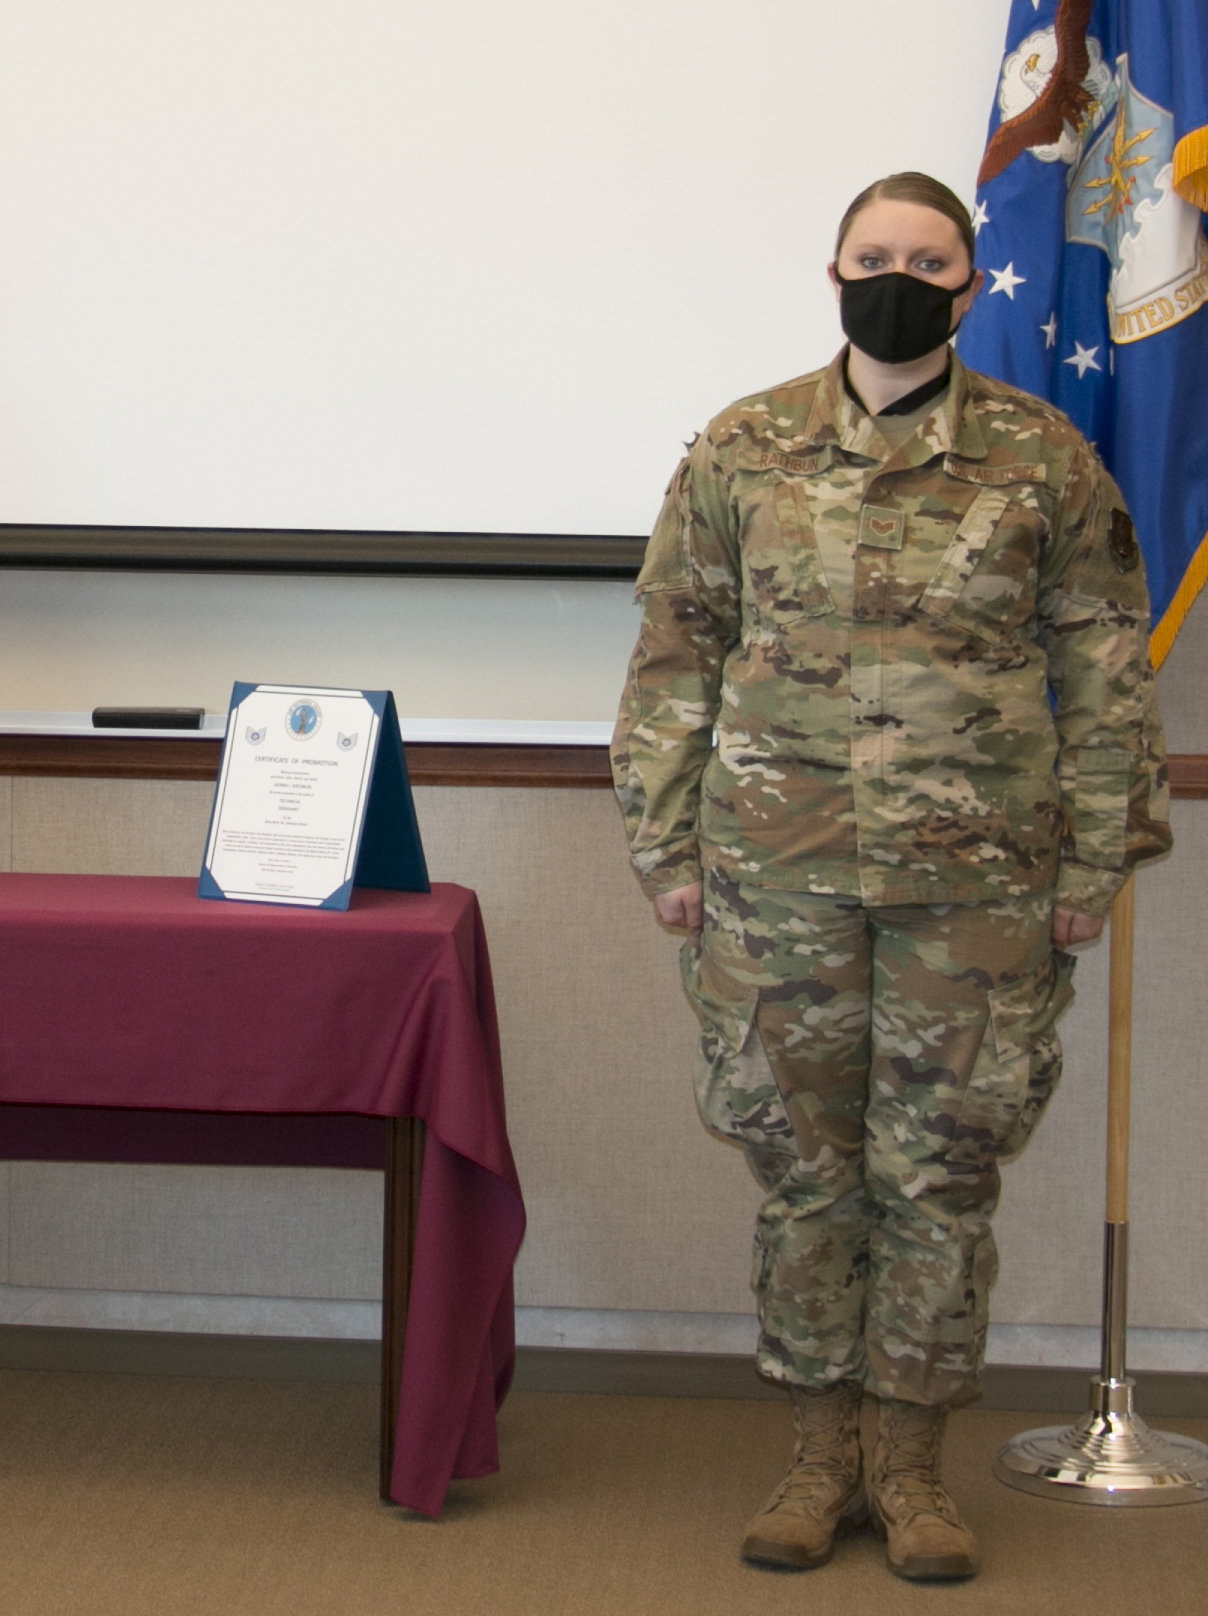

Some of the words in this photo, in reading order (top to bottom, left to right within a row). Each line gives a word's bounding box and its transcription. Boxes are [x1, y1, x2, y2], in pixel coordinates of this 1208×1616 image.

[1114, 297, 1175, 338] NITED
[759, 453, 819, 472] RATHBUN
[974, 468, 994, 483] AIR
[999, 465, 1038, 481] FORCE
[254, 756, 289, 764] CERTIFICATE
[302, 759, 338, 767] PROMOTION
